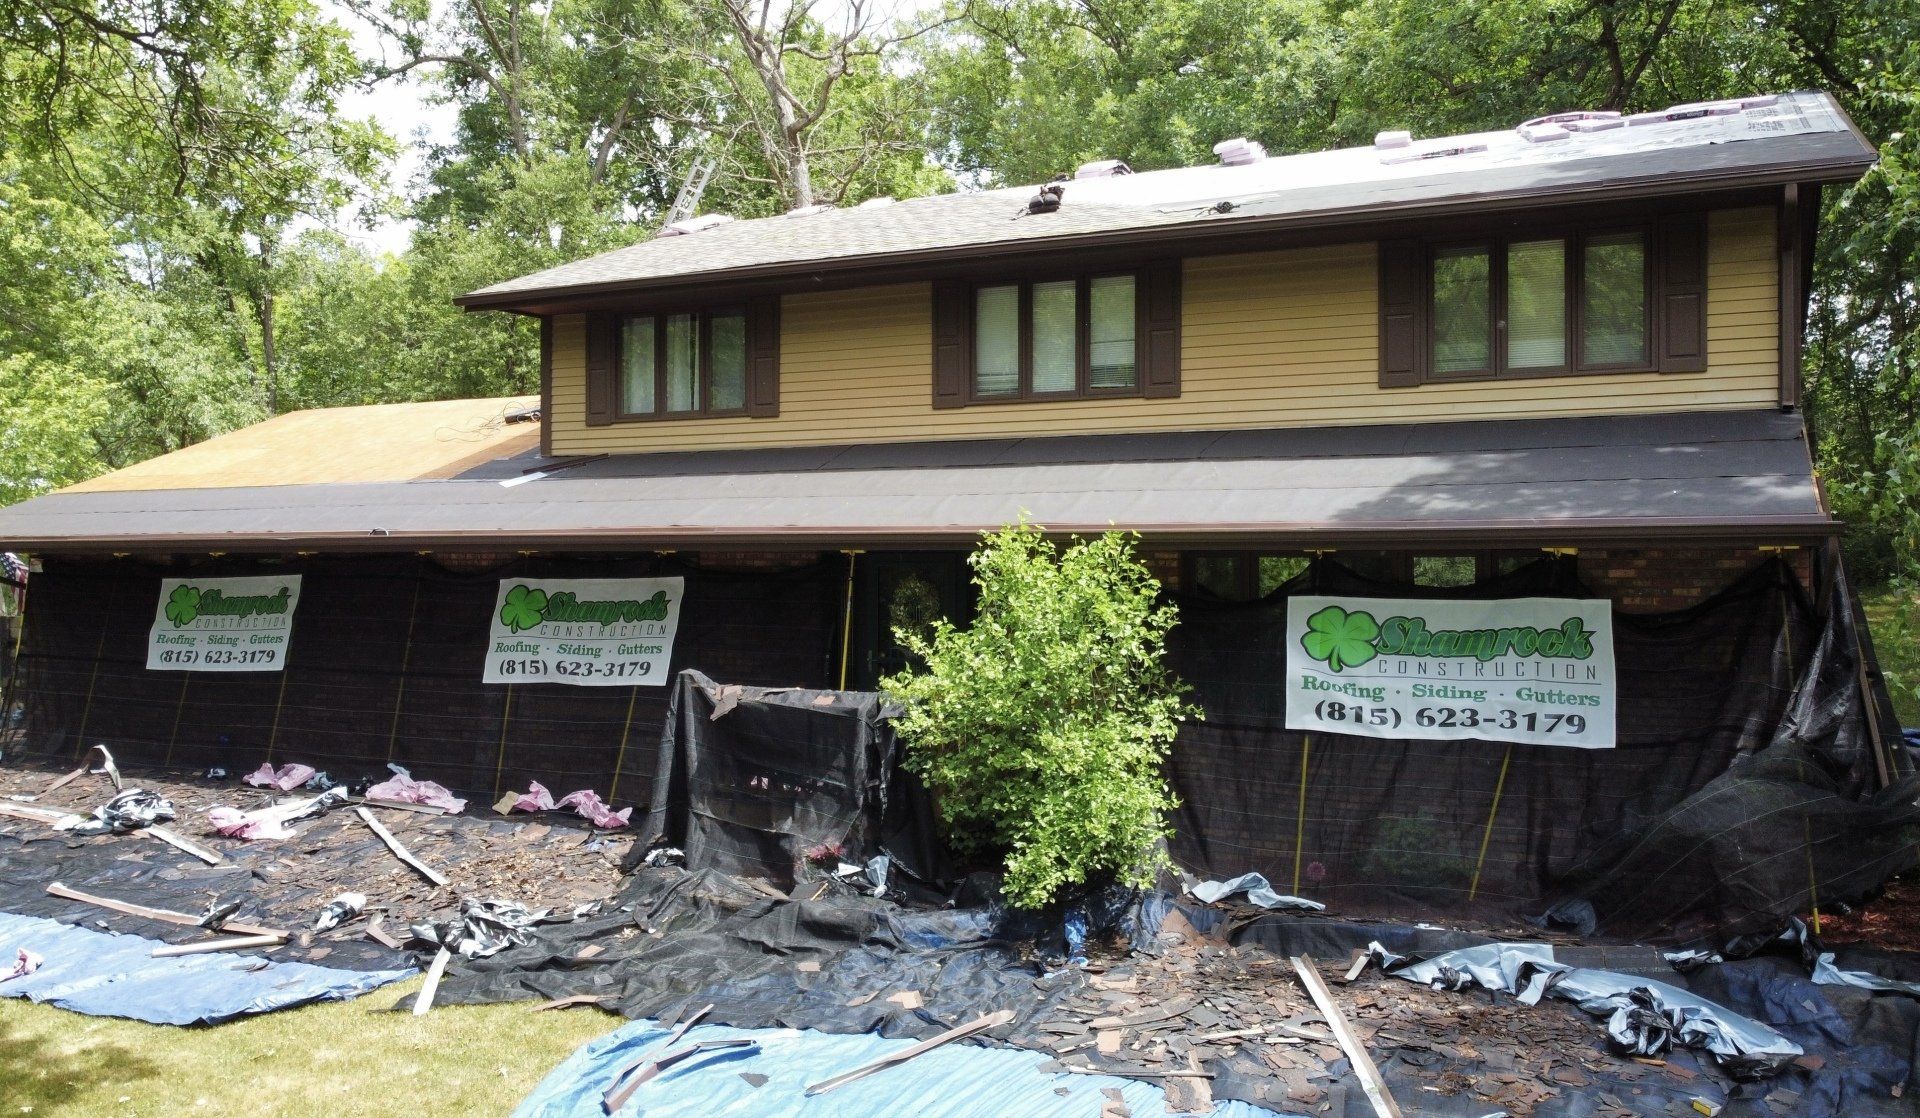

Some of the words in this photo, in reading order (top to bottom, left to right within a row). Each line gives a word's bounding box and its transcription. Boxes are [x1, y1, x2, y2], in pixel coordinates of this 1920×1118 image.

[542, 591, 672, 626] Shamrock
[540, 624, 667, 637] CONSTRUCTION
[1376, 616, 1597, 662] Shamrock
[156, 634, 197, 647] Roofing
[207, 634, 239, 647] Siding
[250, 634, 284, 645] Gutters
[495, 641, 541, 655] Roofing
[556, 643, 603, 658] Siding
[617, 644, 663, 655] Gutters
[160, 650, 199, 664] (815)
[204, 650, 276, 664] 623-3179
[500, 660, 548, 676] (815)
[556, 661, 651, 677] 623-3179
[1378, 659, 1597, 680] CONSTRUCTION
[1301, 675, 1386, 702] Roofing
[1411, 684, 1488, 702] Siding
[1516, 687, 1601, 707] Gutters
[1314, 700, 1402, 729] (815)
[1415, 707, 1587, 735] 623-3179
